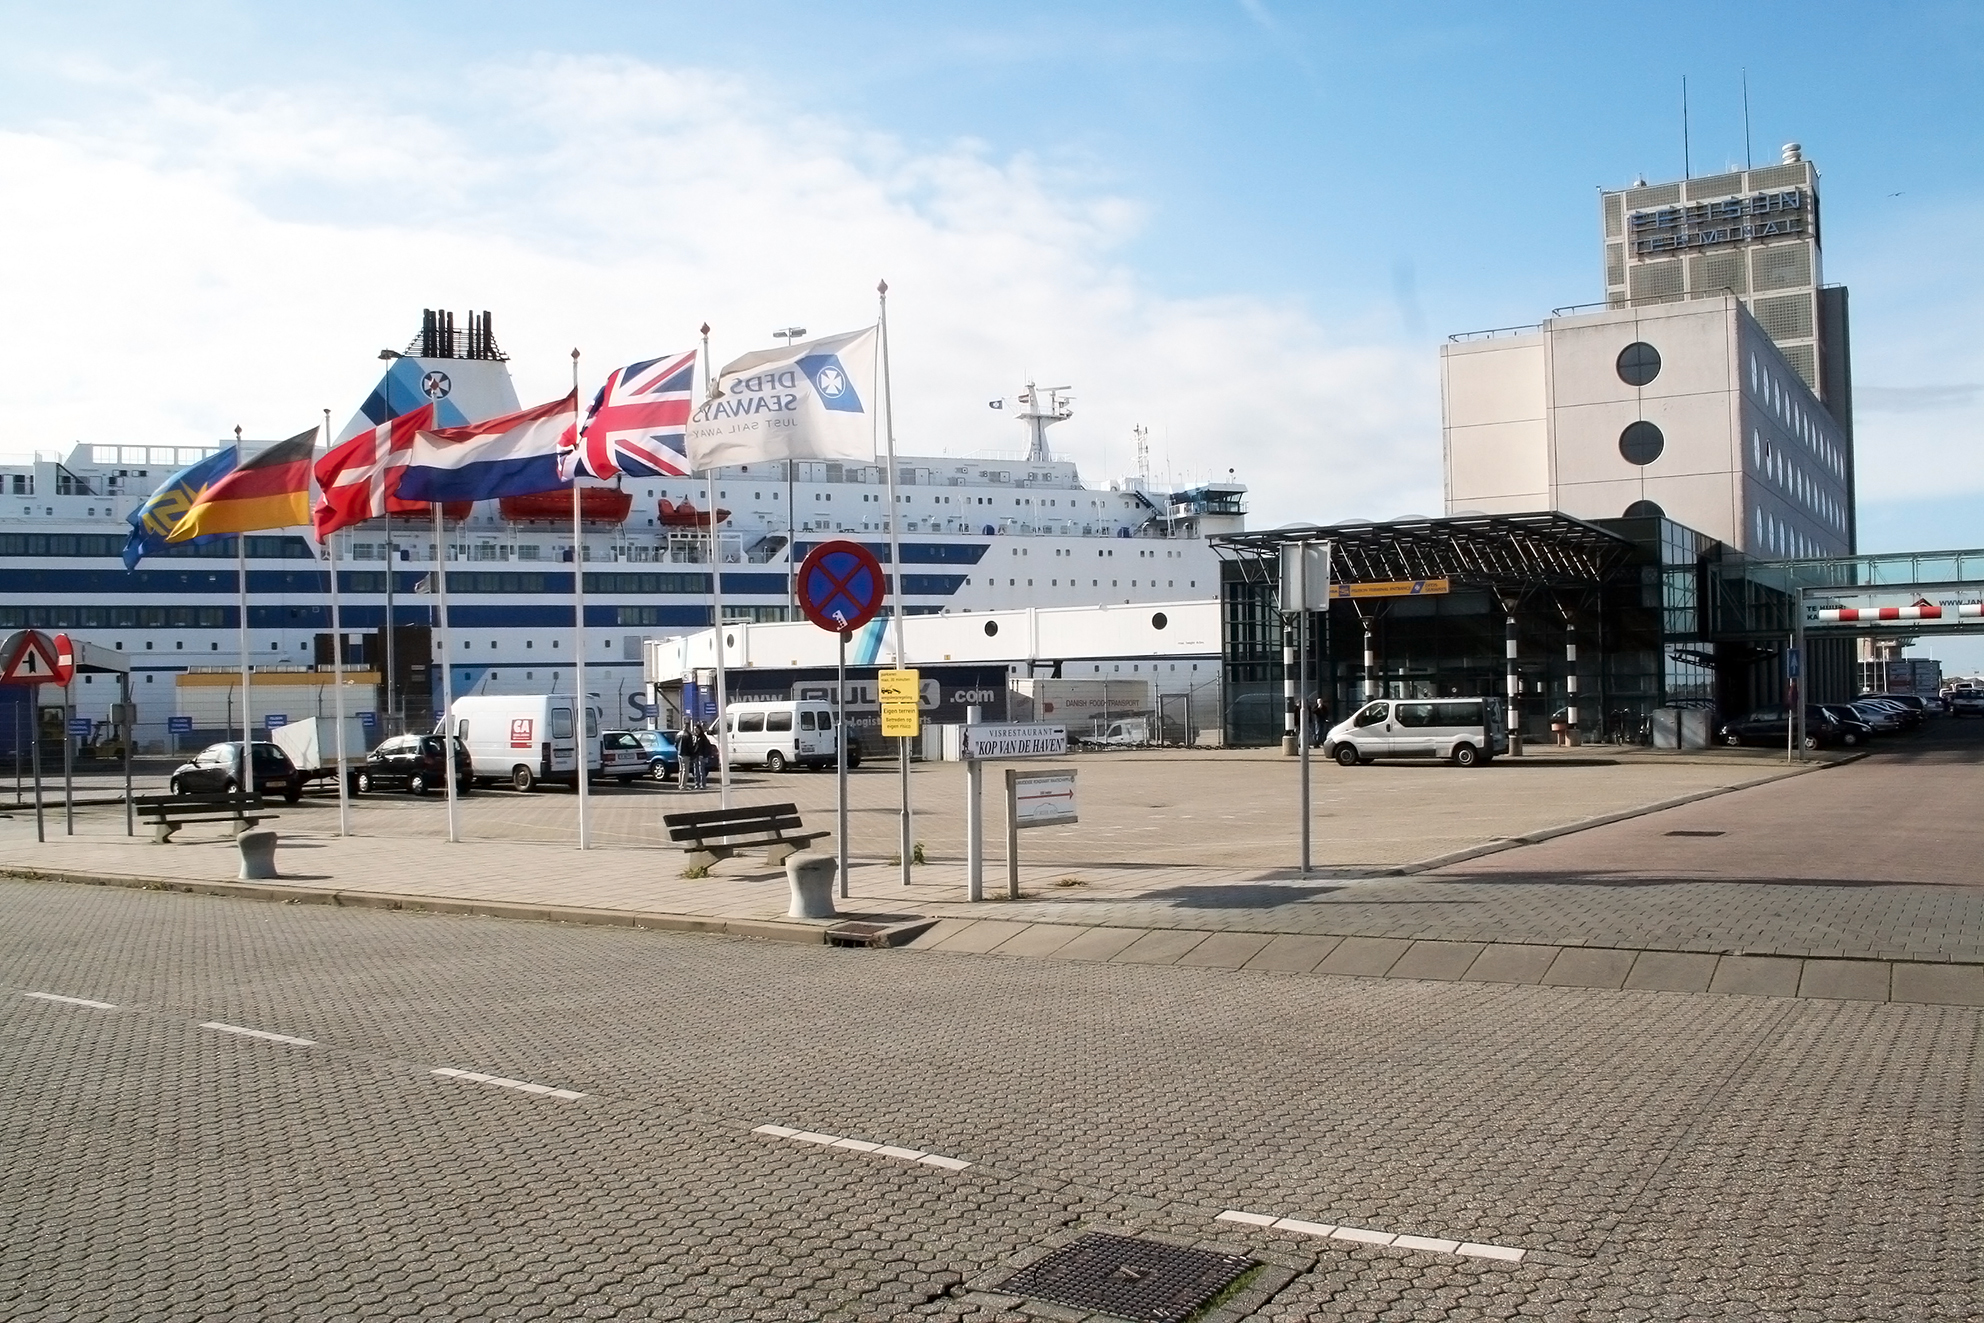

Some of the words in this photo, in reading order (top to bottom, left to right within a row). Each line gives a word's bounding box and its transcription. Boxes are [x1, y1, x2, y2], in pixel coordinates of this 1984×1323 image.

[1630, 190, 1800, 232] FELISON
[1631, 218, 1803, 253] TERMINAL
[950, 690, 995, 703] .com
[1065, 699, 1087, 707] DANISH
[1108, 699, 1139, 707] TRANSPORT
[989, 728, 1053, 737] VISRESTAURANT
[975, 741, 998, 755] "KOP
[999, 740, 1016, 754] VAN
[1018, 739, 1031, 753] DE
[1032, 738, 1065, 753] HAVEN"
